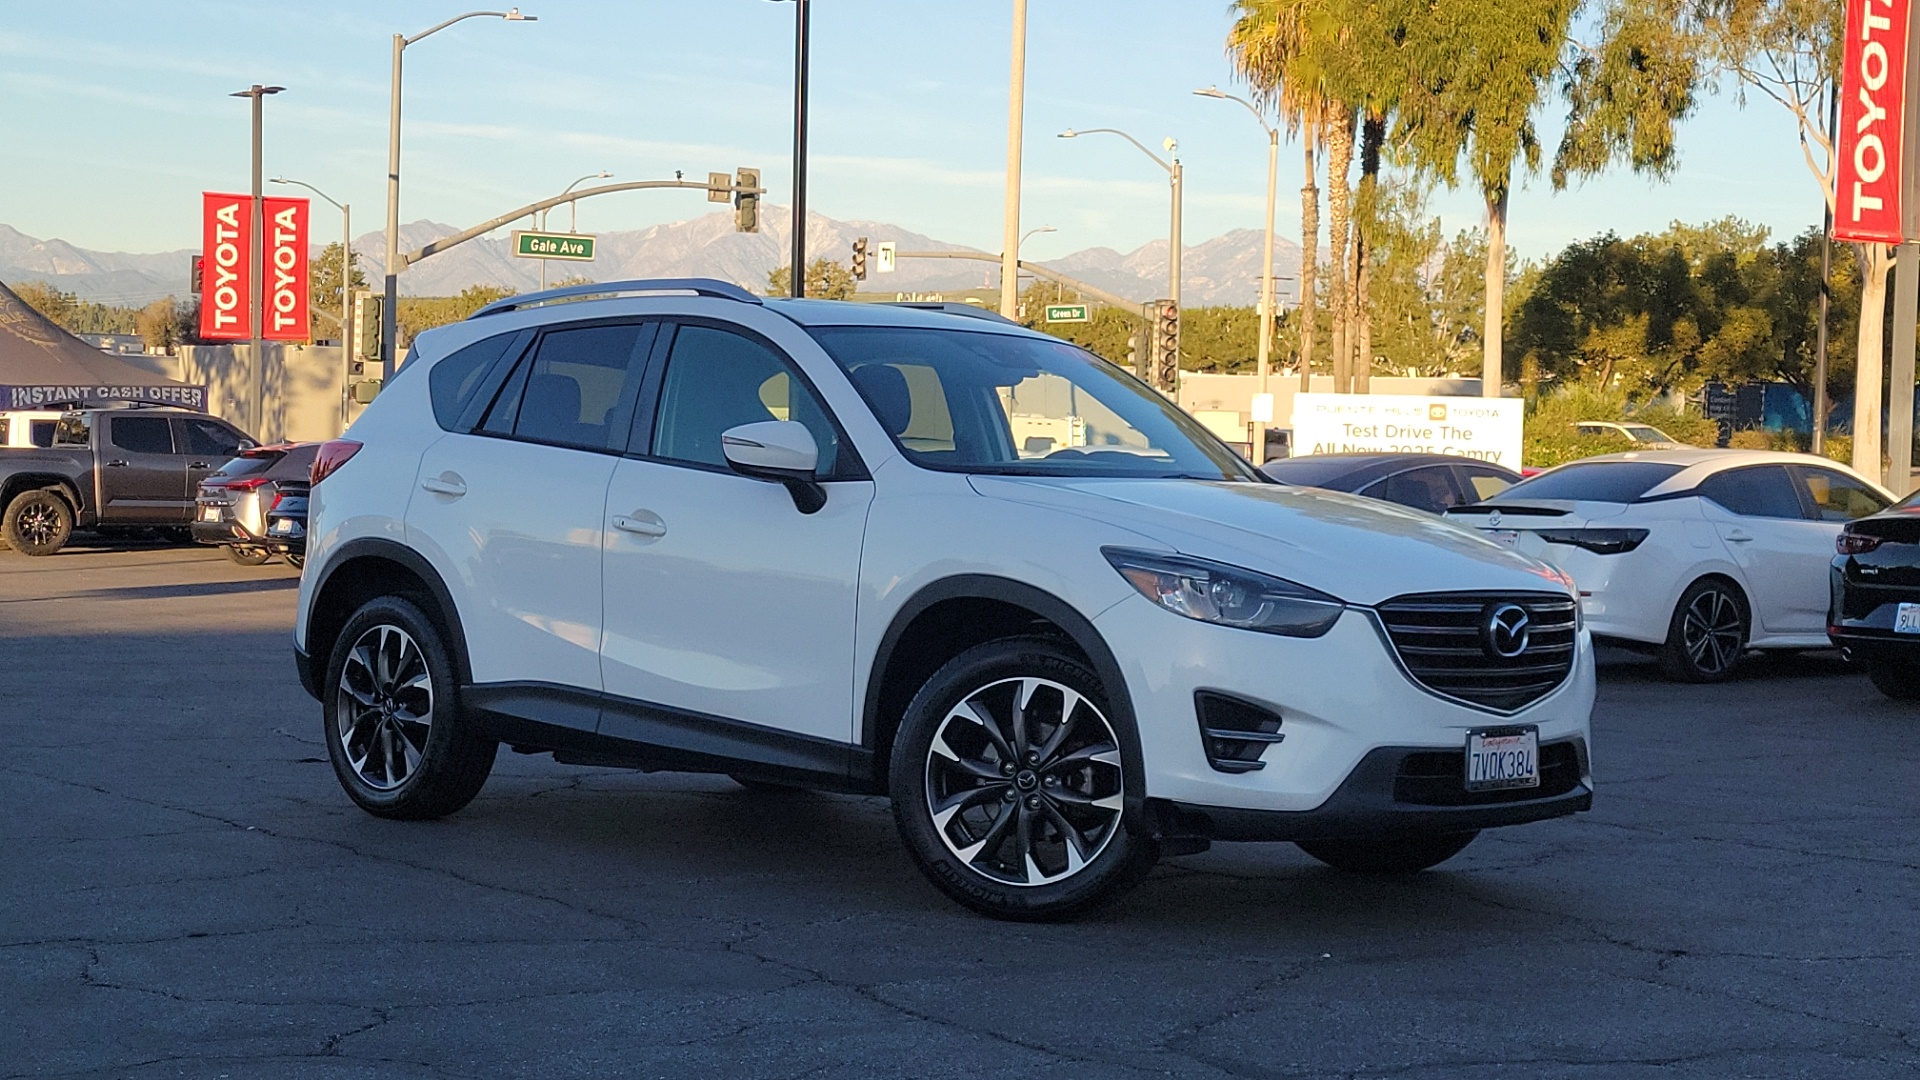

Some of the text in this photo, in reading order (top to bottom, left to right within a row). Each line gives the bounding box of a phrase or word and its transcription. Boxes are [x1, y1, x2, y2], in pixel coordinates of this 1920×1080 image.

[1852, 0, 1893, 222] TOYOT
[530, 238, 584, 254] Gale Ave
[214, 203, 239, 329] TOYOTA
[273, 206, 297, 332] TOYOTA
[1052, 308, 1082, 318] Green Dr
[11, 386, 202, 408] INSTANT CASH OFFER
[1452, 408, 1499, 418] TOYOTA
[1342, 423, 1473, 441] Test Drive The
[1312, 442, 1336, 455] All
[1442, 446, 1502, 463] Camry
